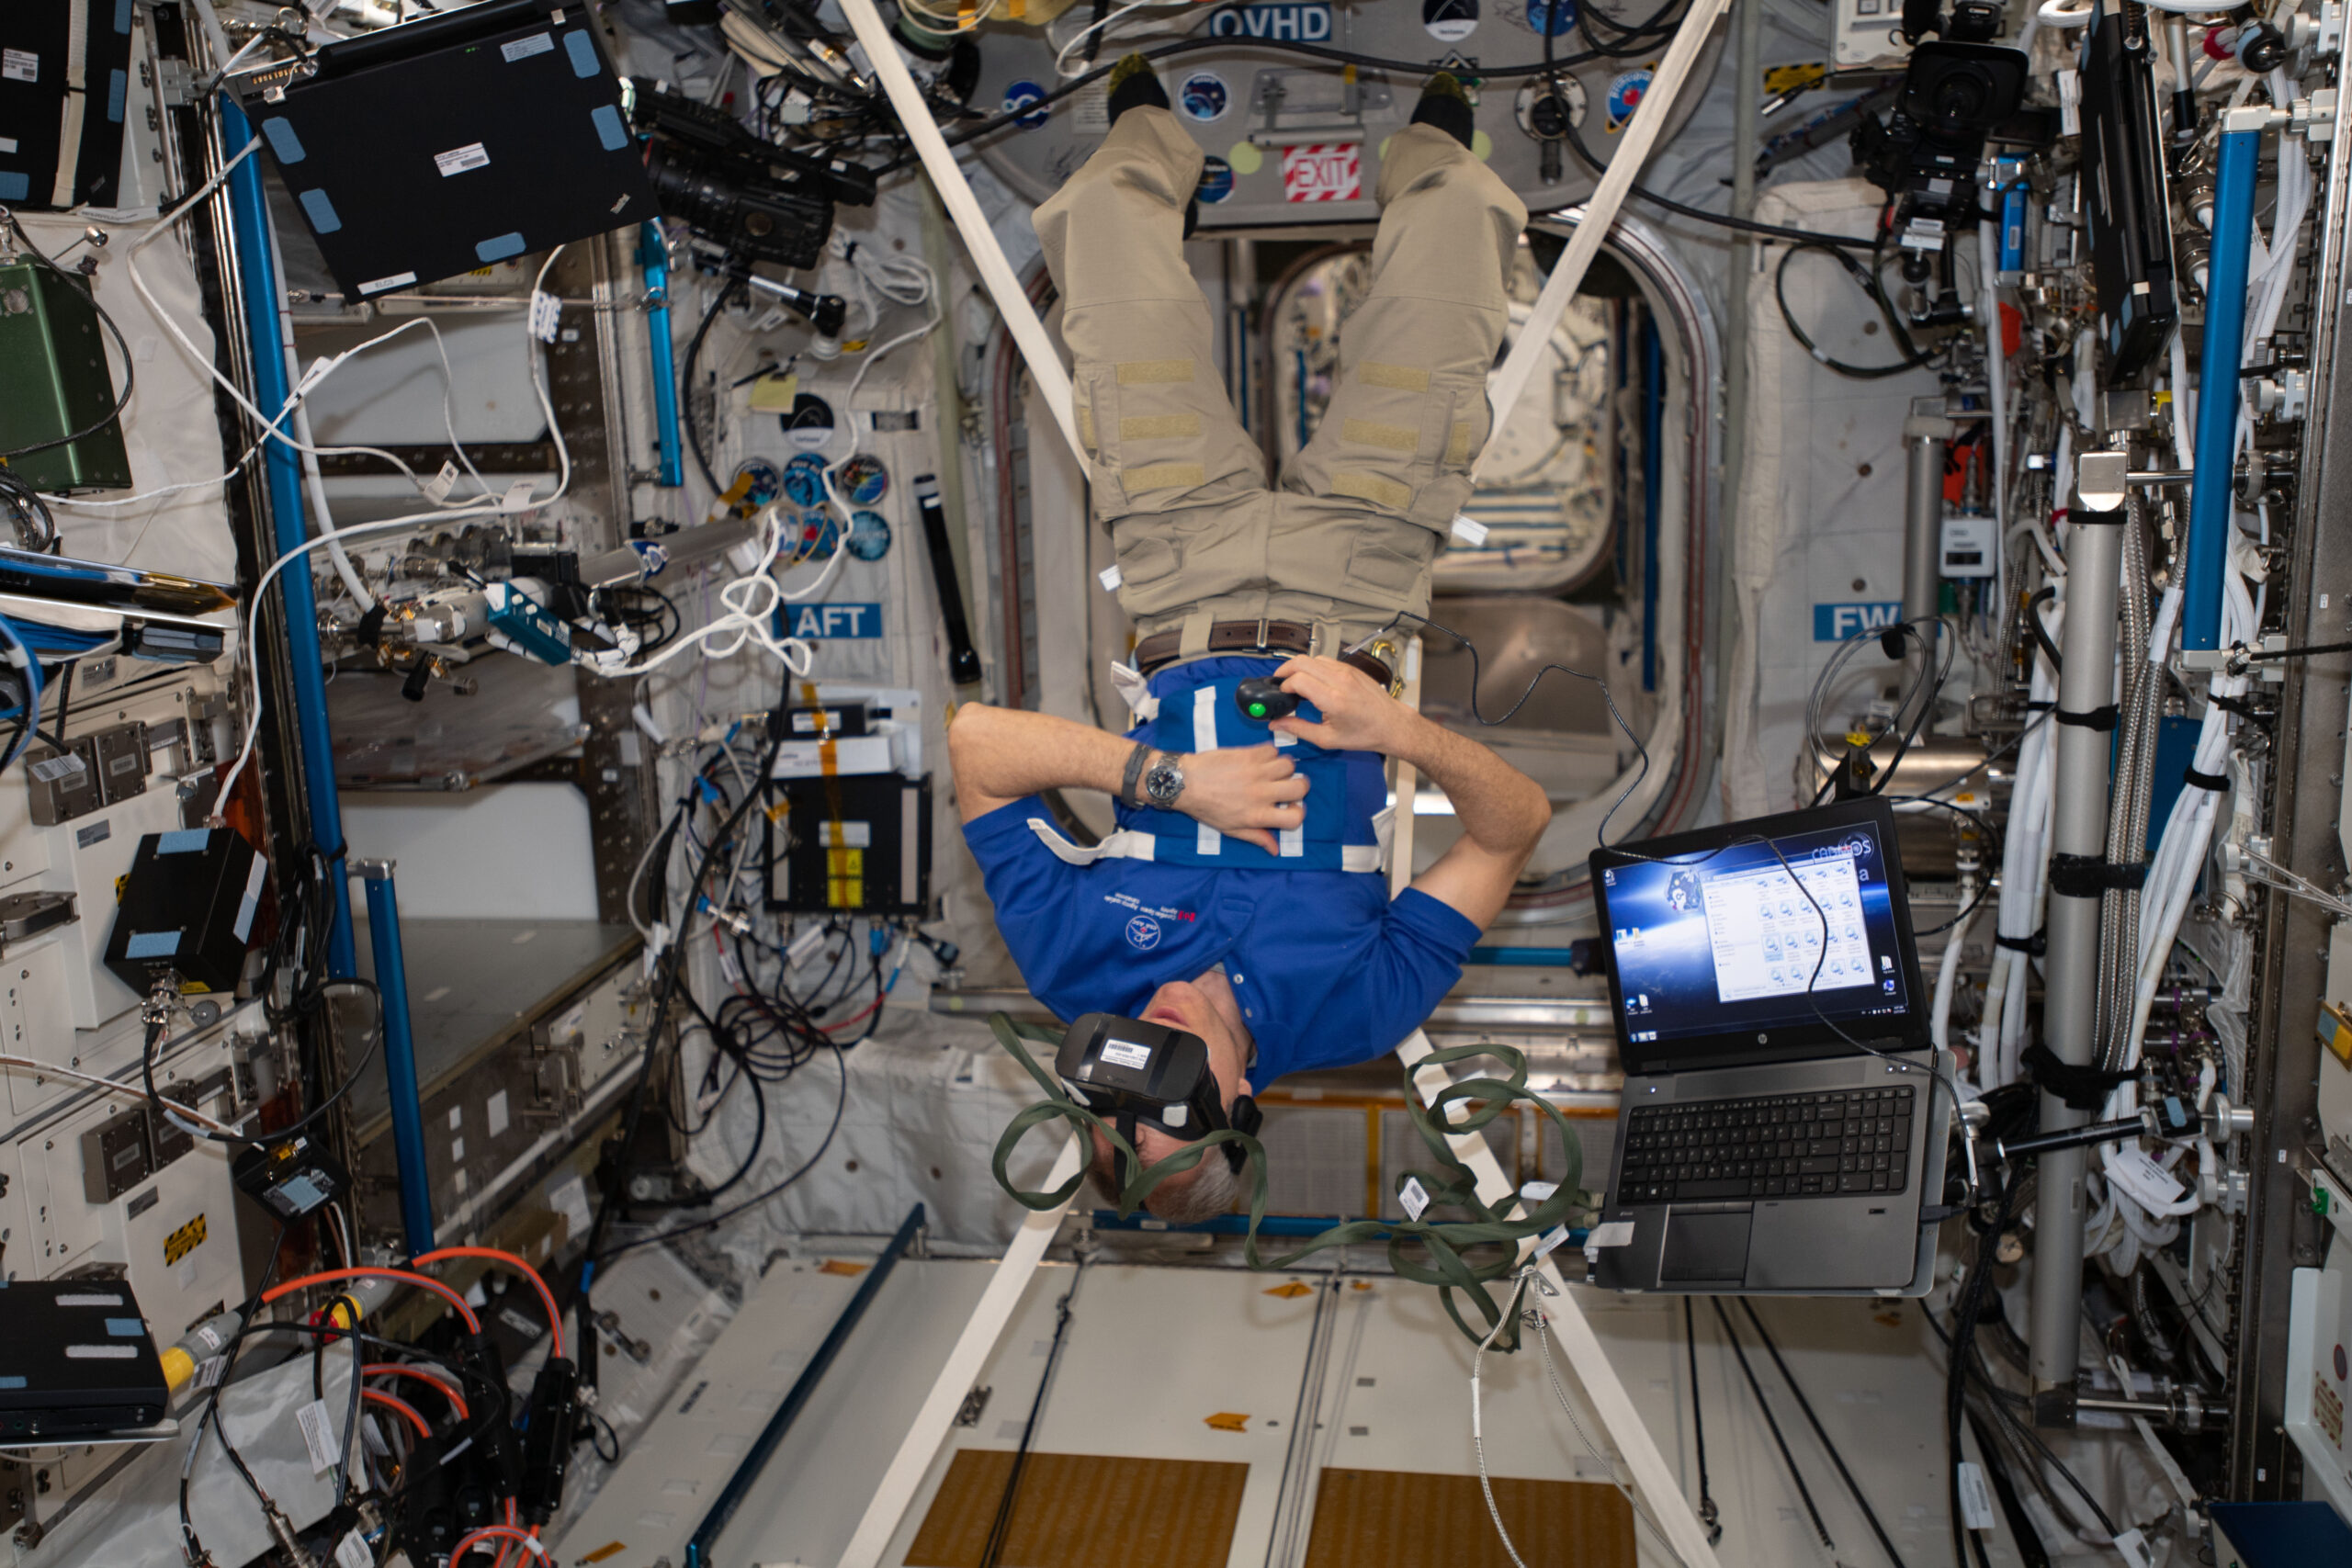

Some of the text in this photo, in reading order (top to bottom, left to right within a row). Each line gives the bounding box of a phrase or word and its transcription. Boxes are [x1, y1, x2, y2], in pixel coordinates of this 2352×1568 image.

[1212, 6, 1330, 40] OVHD
[1295, 156, 1348, 188] EXIT
[796, 606, 866, 637] AFT
[1833, 604, 1900, 639] FW
